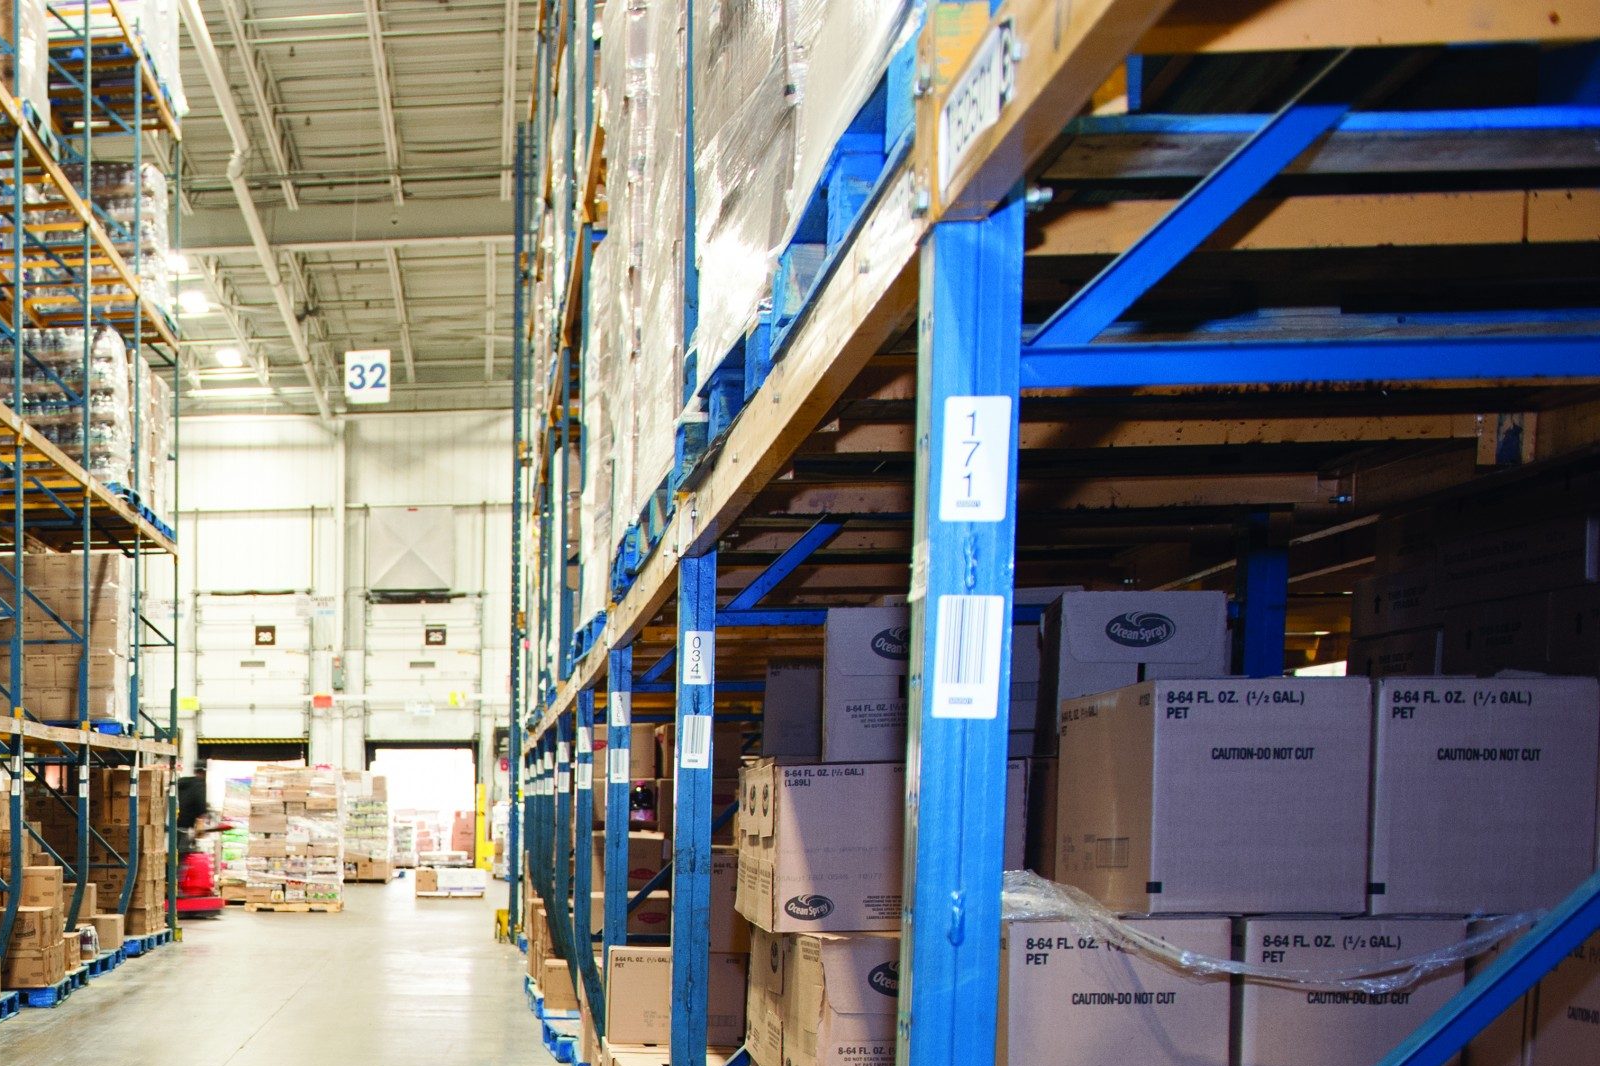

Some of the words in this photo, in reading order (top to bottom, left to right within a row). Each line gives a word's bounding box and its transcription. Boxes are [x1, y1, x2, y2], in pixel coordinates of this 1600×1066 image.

[348, 363, 387, 390] 32
[961, 409, 981, 498] 171
[1110, 622, 1138, 641] Ocean
[1139, 623, 1168, 642] Spray
[874, 637, 901, 654] Ocean
[690, 636, 702, 675] 034
[1166, 690, 1194, 704] 8-64
[1197, 690, 1215, 704] FL.
[1218, 690, 1238, 704] OZ.
[1272, 690, 1305, 705] GAL.)
[1392, 690, 1420, 704] 8-64
[1423, 690, 1441, 704] FL.
[1444, 690, 1466, 704] OZ.
[1500, 691, 1533, 705] GAL.)
[1166, 707, 1189, 719] PET
[1392, 706, 1416, 719] PET
[1211, 747, 1271, 761] CAUTION-DO
[1273, 748, 1293, 760] NOT
[1295, 748, 1314, 760] CUT
[1437, 748, 1497, 762] CAUTION-DO
[1499, 748, 1520, 761] NOT
[1521, 748, 1542, 762] CUT
[784, 769, 802, 778] 8-64
[804, 769, 815, 777] FL.
[817, 769, 829, 777] OZ.
[844, 768, 864, 776] GAL.)
[784, 778, 811, 787] (1.89L)
[787, 902, 809, 915] Ocean
[808, 903, 828, 917] Spray
[1025, 938, 1053, 950] 8-64
[1057, 938, 1074, 950] FL.
[1078, 938, 1099, 950] OZ.
[1262, 935, 1289, 948] 8-64
[1293, 935, 1310, 948] FL.
[1313, 935, 1335, 948] OZ.
[1369, 935, 1401, 949] GAL.)
[1025, 953, 1049, 965] PET
[1262, 950, 1285, 963] PET
[872, 971, 899, 988] Ocea
[1072, 992, 1132, 1005] CAUTION-DO
[1134, 992, 1154, 1005] NOT
[1156, 992, 1176, 1004] CUT
[1307, 991, 1367, 1005] CAUTION-DO
[1391, 992, 1411, 1005] CUT
[837, 1046, 856, 1055] 8-64
[858, 1046, 871, 1055] FL.
[873, 1046, 886, 1055] OZ.
